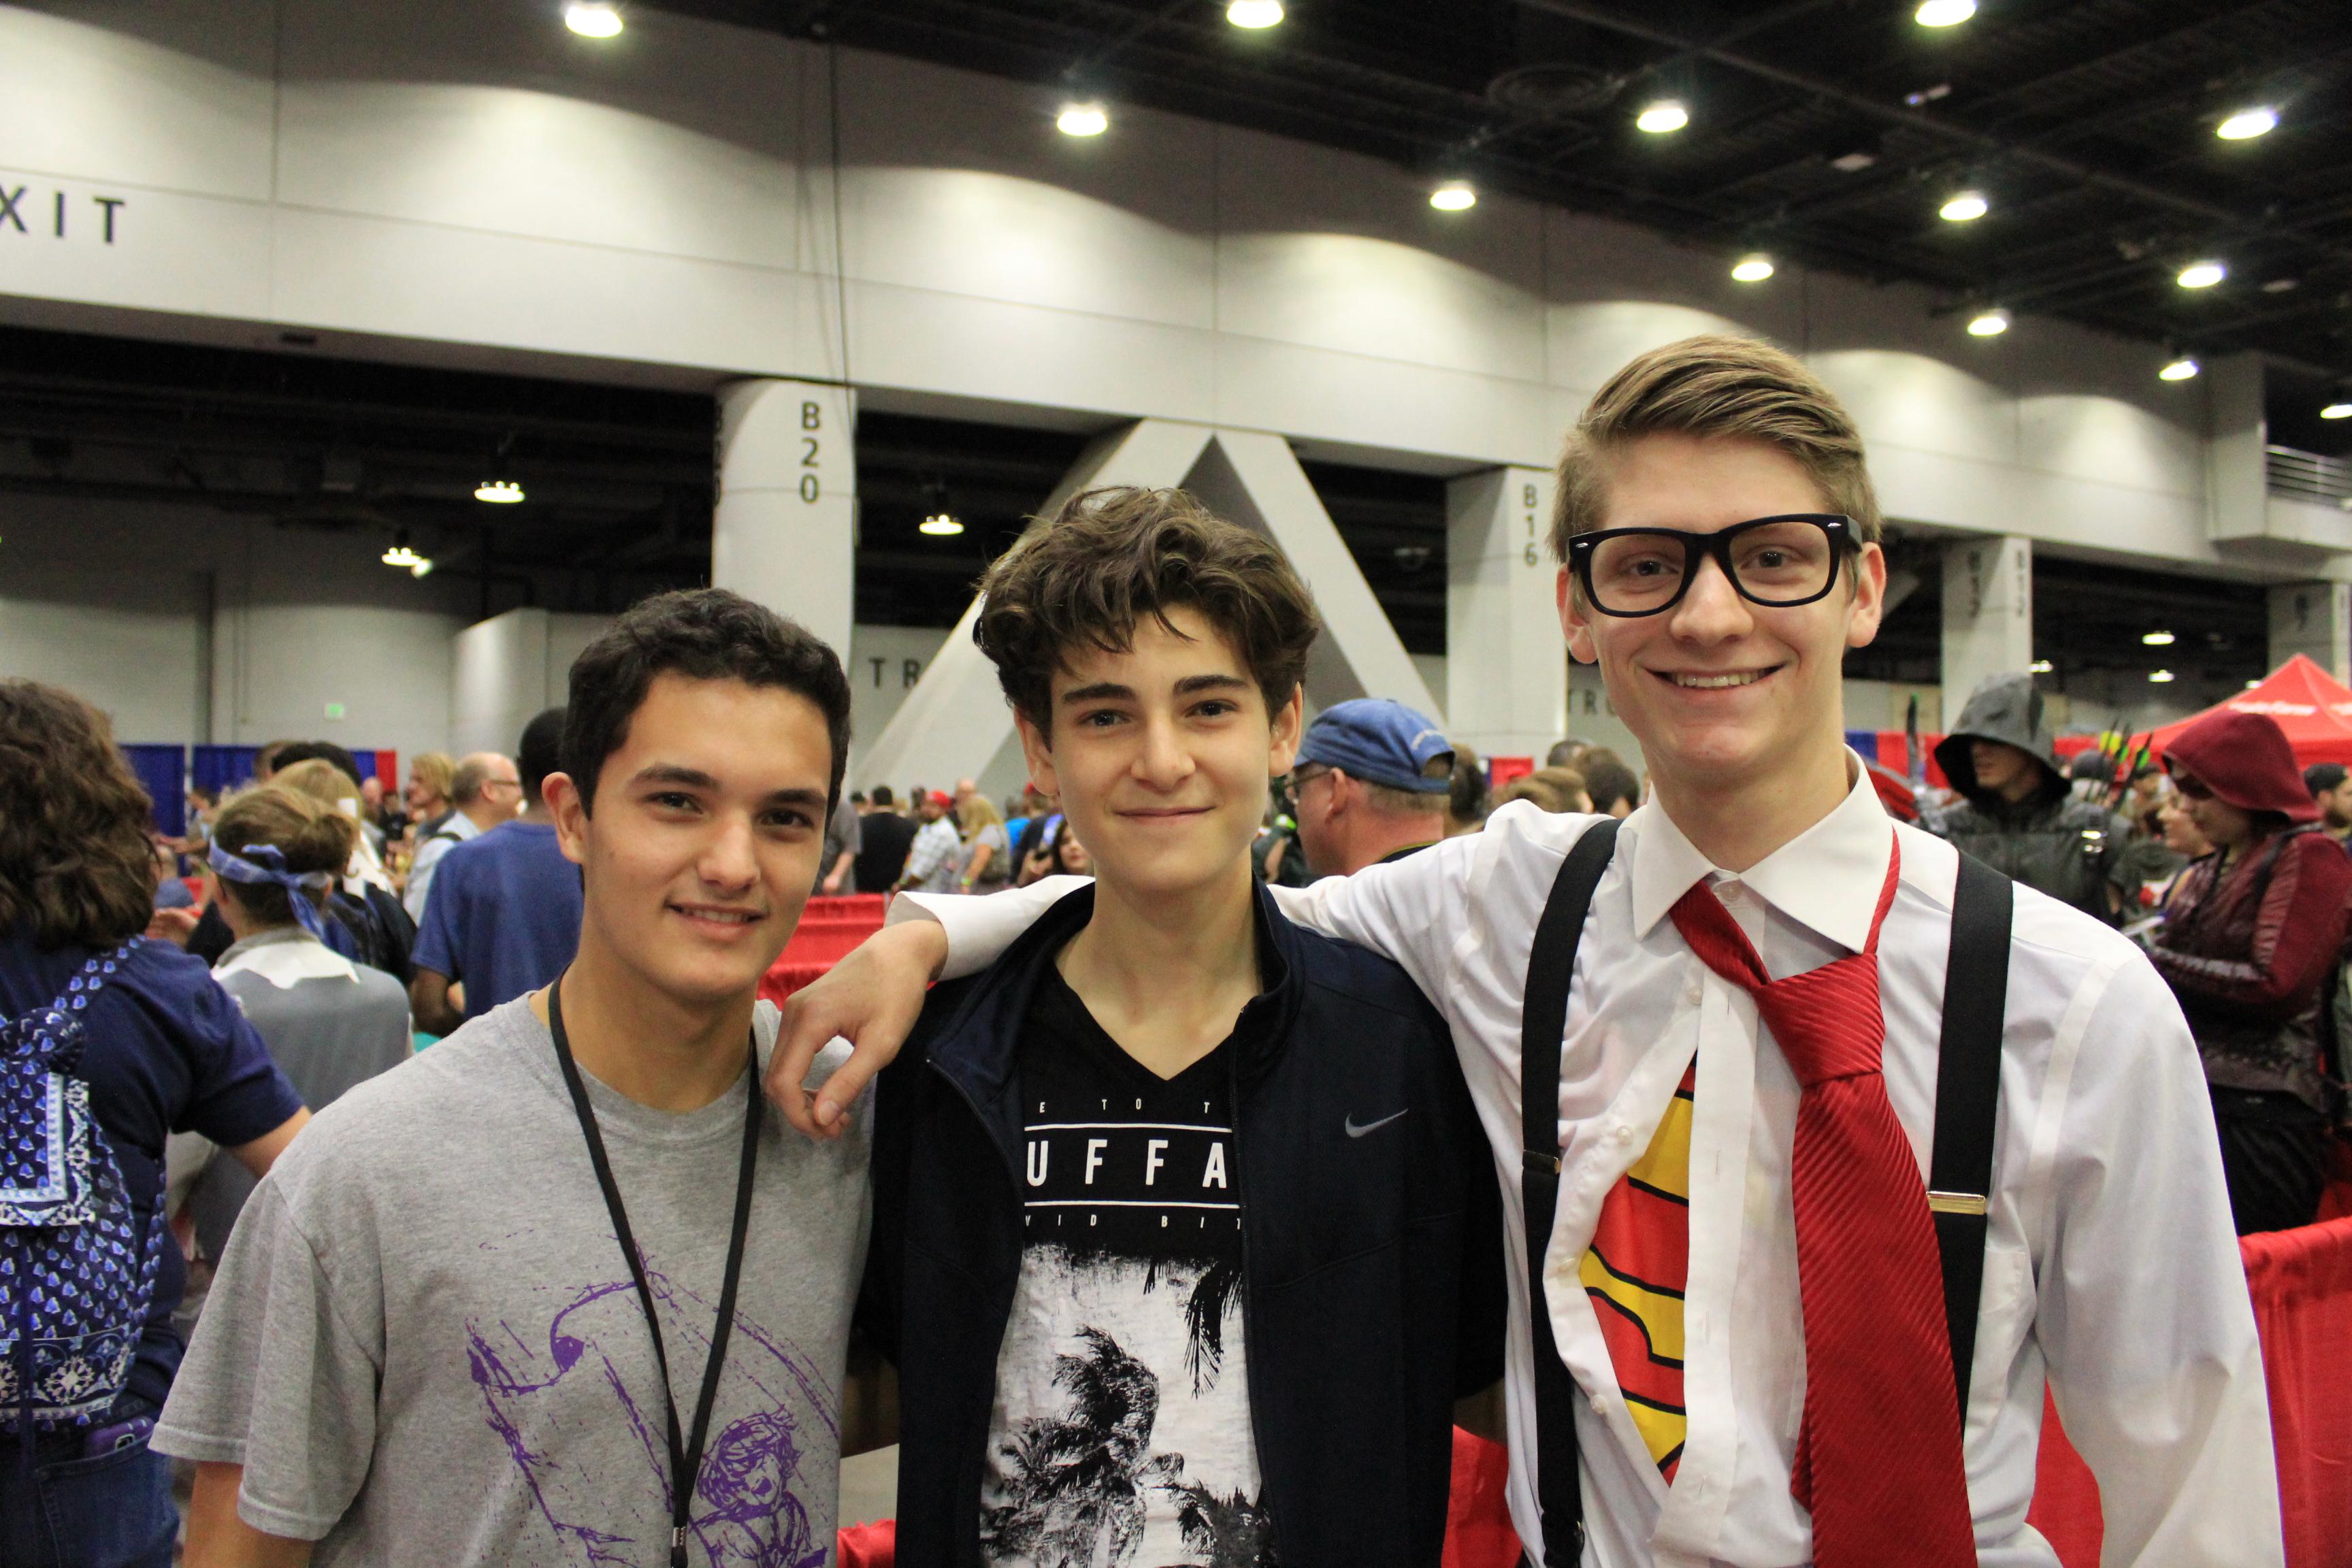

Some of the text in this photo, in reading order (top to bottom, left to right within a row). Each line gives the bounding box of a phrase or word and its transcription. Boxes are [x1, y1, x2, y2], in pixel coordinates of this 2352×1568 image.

[800, 401, 819, 504] B20
[1524, 484, 1537, 566] B16
[1026, 1139, 1227, 1189] UFFA
